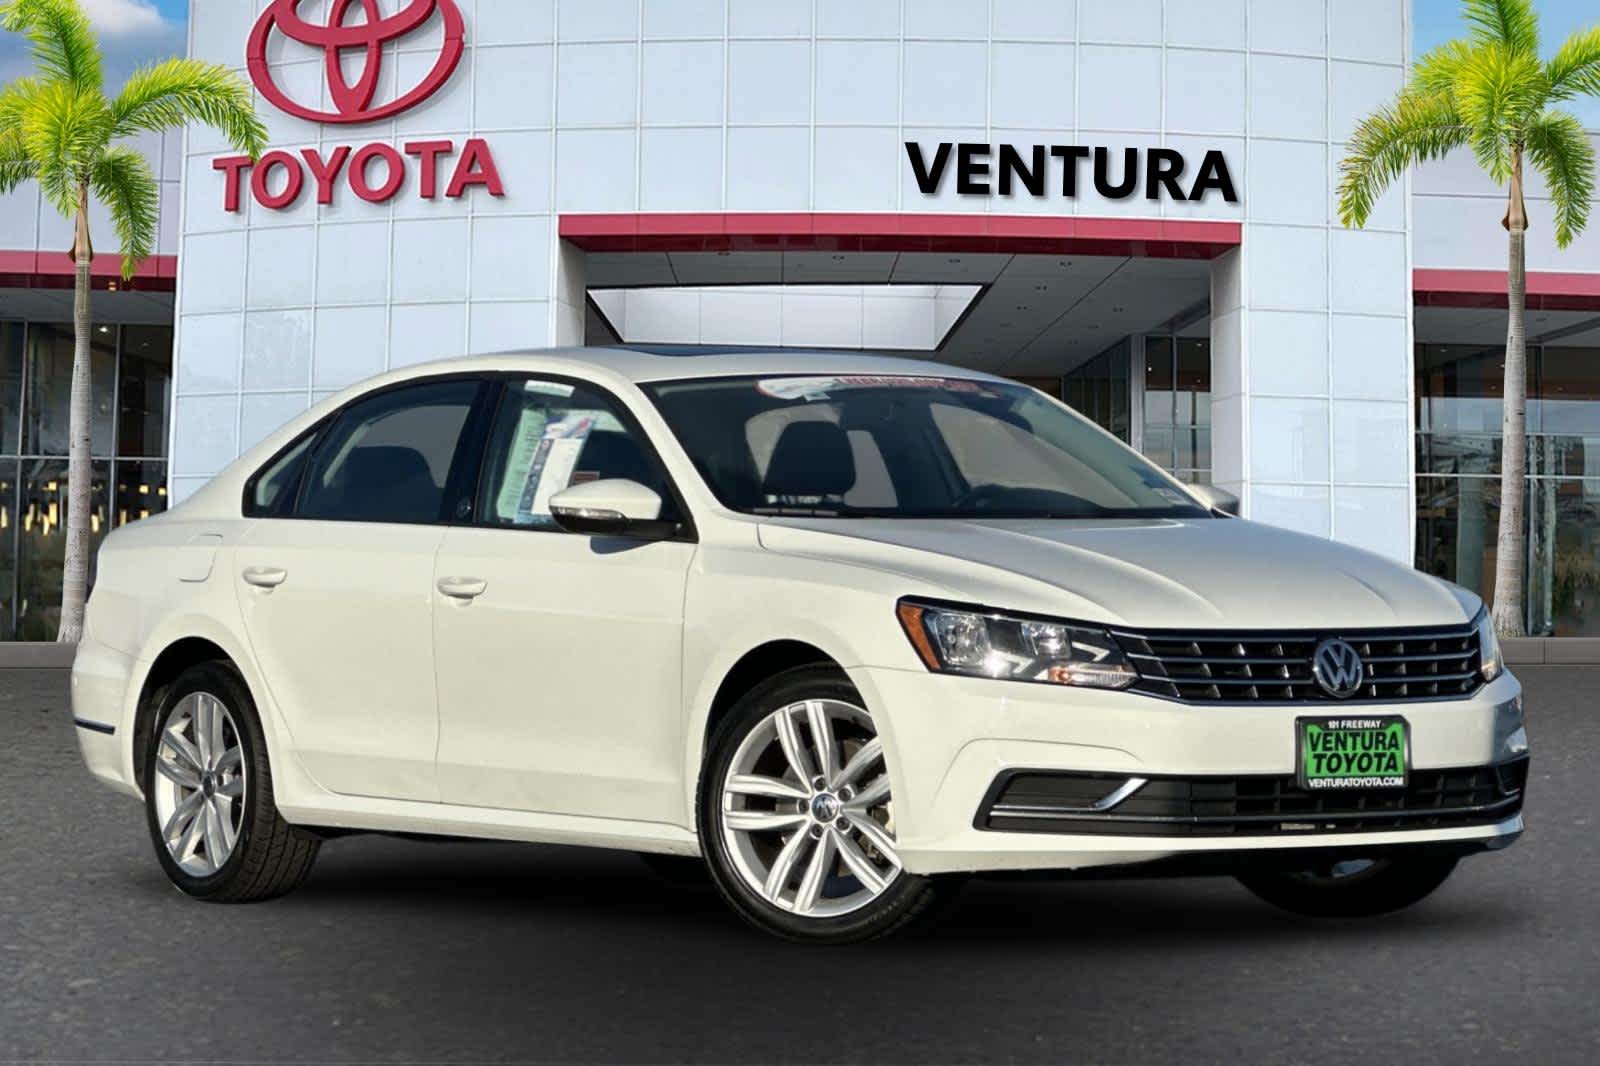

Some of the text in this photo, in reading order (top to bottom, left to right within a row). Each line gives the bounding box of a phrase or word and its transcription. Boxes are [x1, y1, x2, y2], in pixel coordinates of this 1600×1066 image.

[213, 138, 505, 212] TOYOTA
[904, 142, 1239, 202] VENTURA
[1341, 720, 1381, 728] FREEWAY
[1309, 731, 1400, 751] VENTURA
[1313, 752, 1398, 773] TOYOTA
[1308, 777, 1403, 788] VENTURATOYOTA.COM
